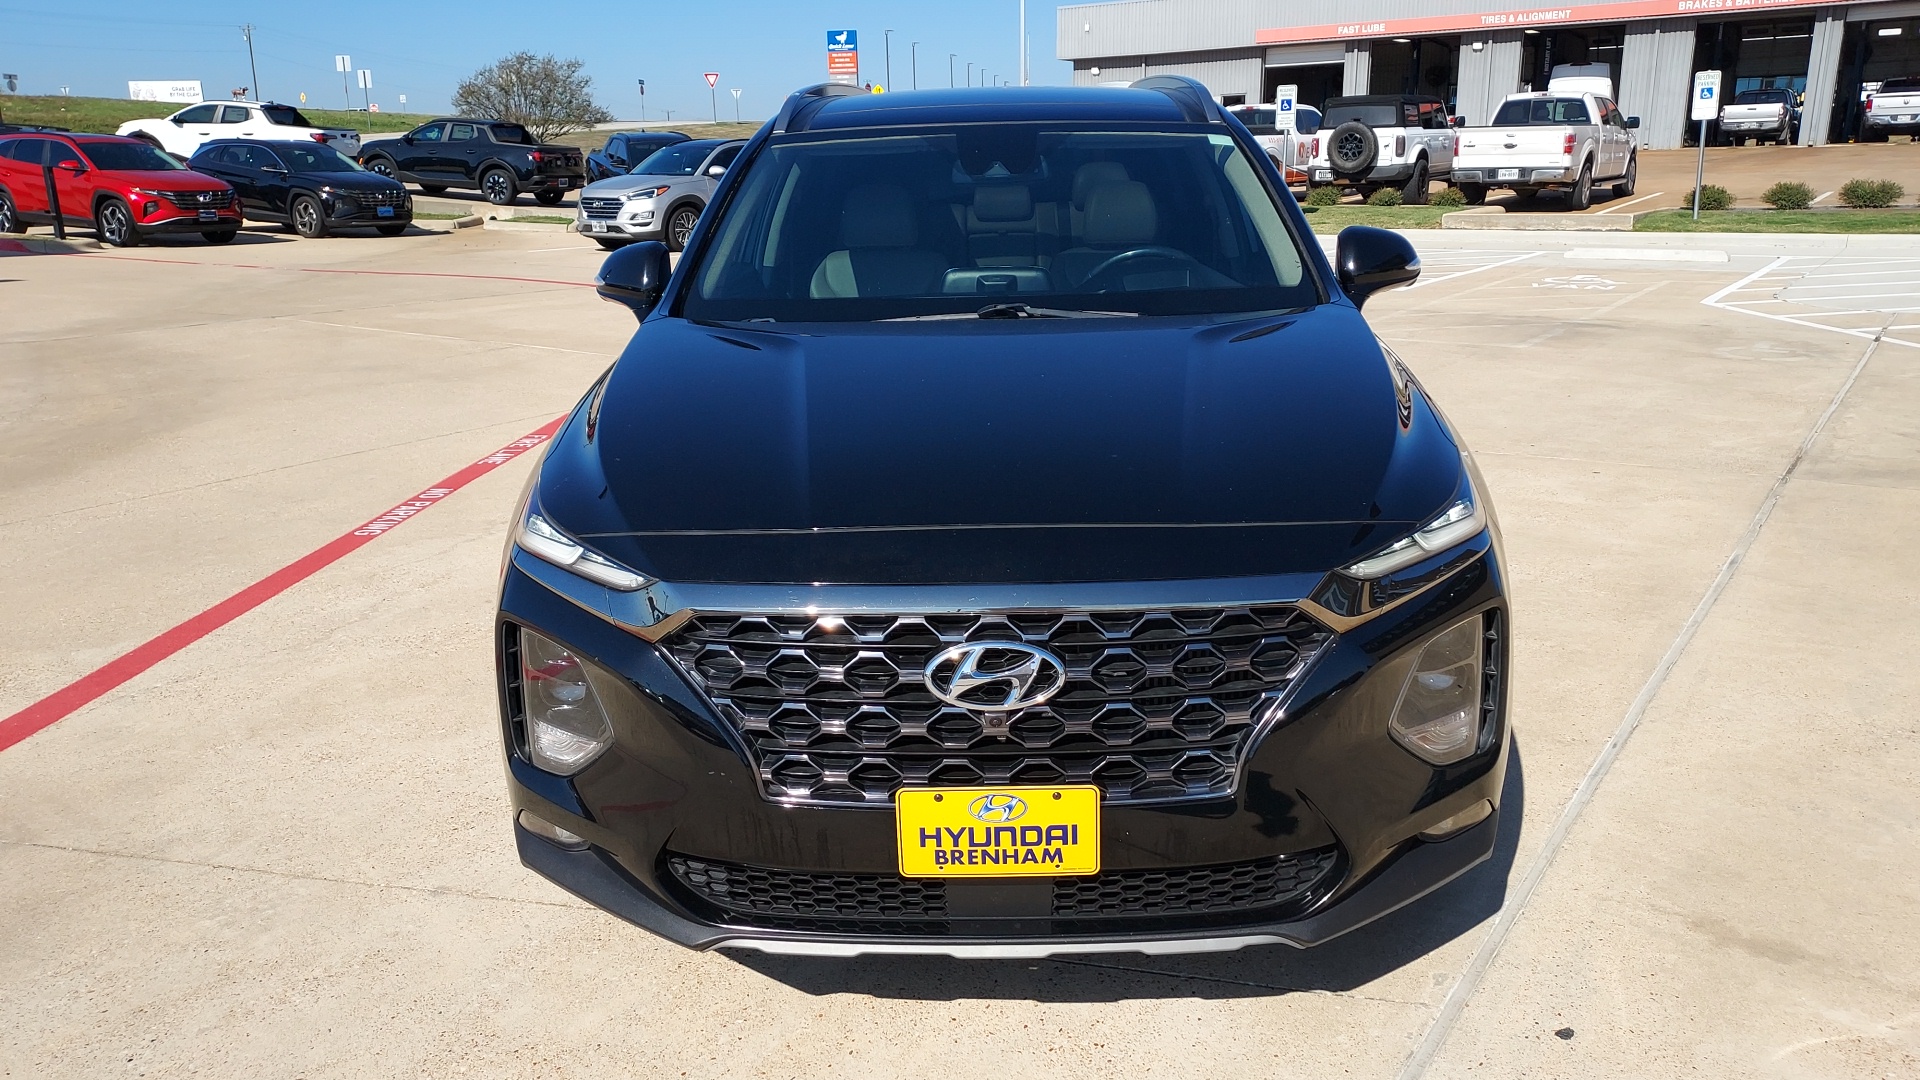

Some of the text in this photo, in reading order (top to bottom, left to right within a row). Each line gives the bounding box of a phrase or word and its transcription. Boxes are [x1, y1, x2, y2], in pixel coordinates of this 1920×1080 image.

[1678, 0, 1722, 10] BRAKES
[1481, 9, 1572, 24] TIRES & ALIGNMENT
[1337, 23, 1386, 34] FAST LUBE
[476, 434, 549, 465] FIRE LANE
[353, 488, 454, 536] NO PARKING
[919, 824, 1078, 848] HYUNDAI
[934, 847, 1064, 866] BRENHAM
